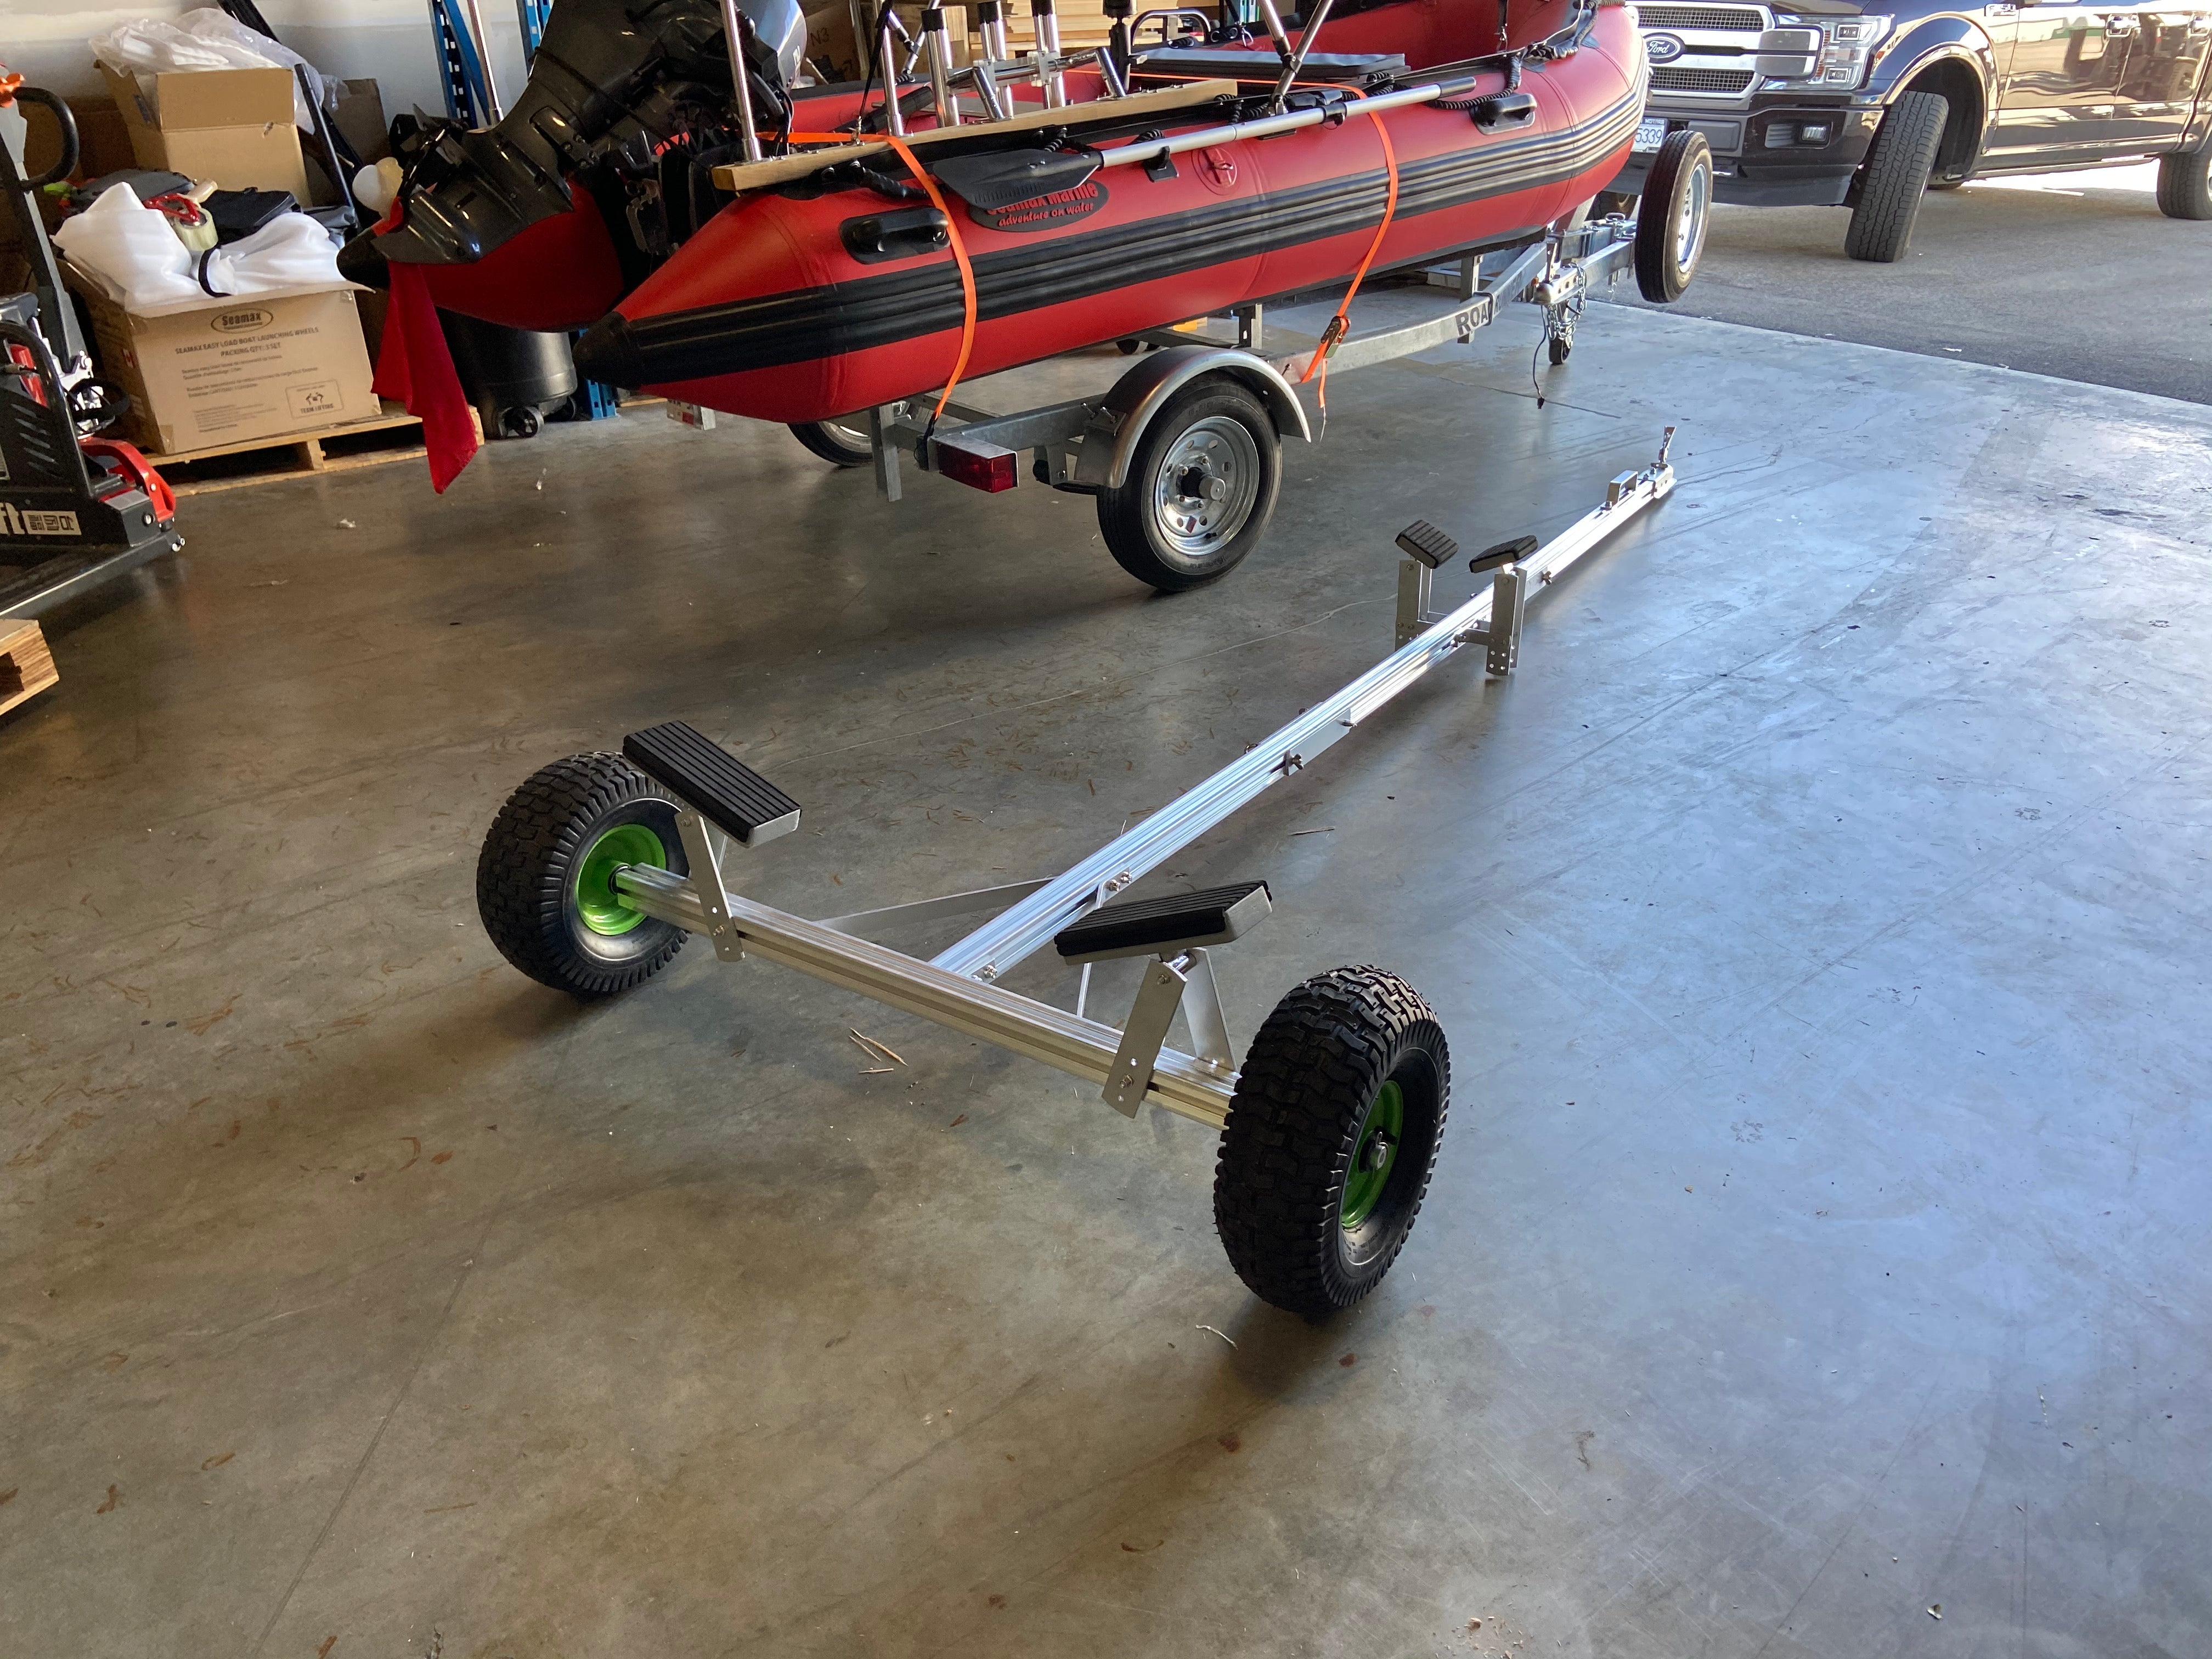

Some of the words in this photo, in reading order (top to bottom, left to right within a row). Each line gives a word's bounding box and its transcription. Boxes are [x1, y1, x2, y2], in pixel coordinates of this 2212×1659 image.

[1647, 41, 1671, 54] Ford
[1635, 128, 1662, 144] 5339
[998, 211, 1049, 226] adventure
[1051, 209, 1064, 217] on
[1066, 202, 1093, 215] water
[222, 312, 261, 326] Seamax
[176, 344, 202, 354] SEAMAX
[202, 342, 219, 350] EASY
[221, 339, 238, 347] LOAD
[257, 330, 294, 341] LAUNCHING
[295, 327, 319, 335] WHEELS
[221, 347, 249, 357] PACKING
